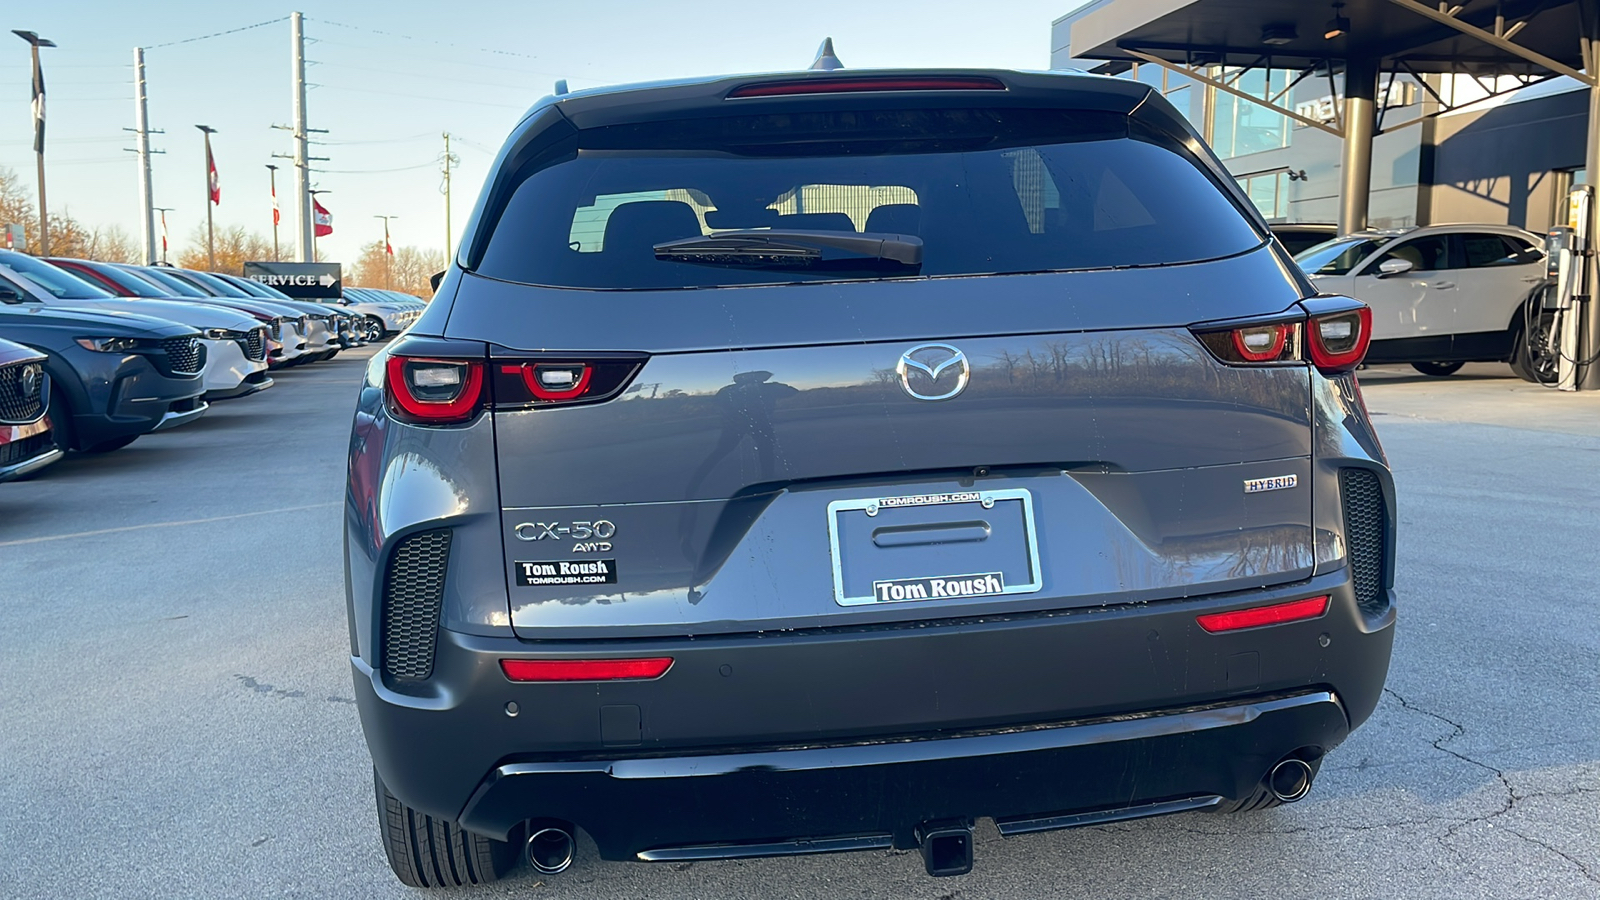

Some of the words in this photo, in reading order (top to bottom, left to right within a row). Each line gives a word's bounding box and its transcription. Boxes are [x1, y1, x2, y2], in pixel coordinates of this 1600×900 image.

[1249, 476, 1295, 491] HYBRID
[879, 493, 980, 506] TOMROUSH.COM
[514, 520, 616, 541] CX-50
[572, 542, 612, 552] AWD
[522, 563, 557, 576] Tom
[559, 560, 609, 575] Roush
[527, 576, 606, 585] TOMROUSH.COM
[877, 583, 928, 601] Tom
[930, 574, 1002, 598] Roush
